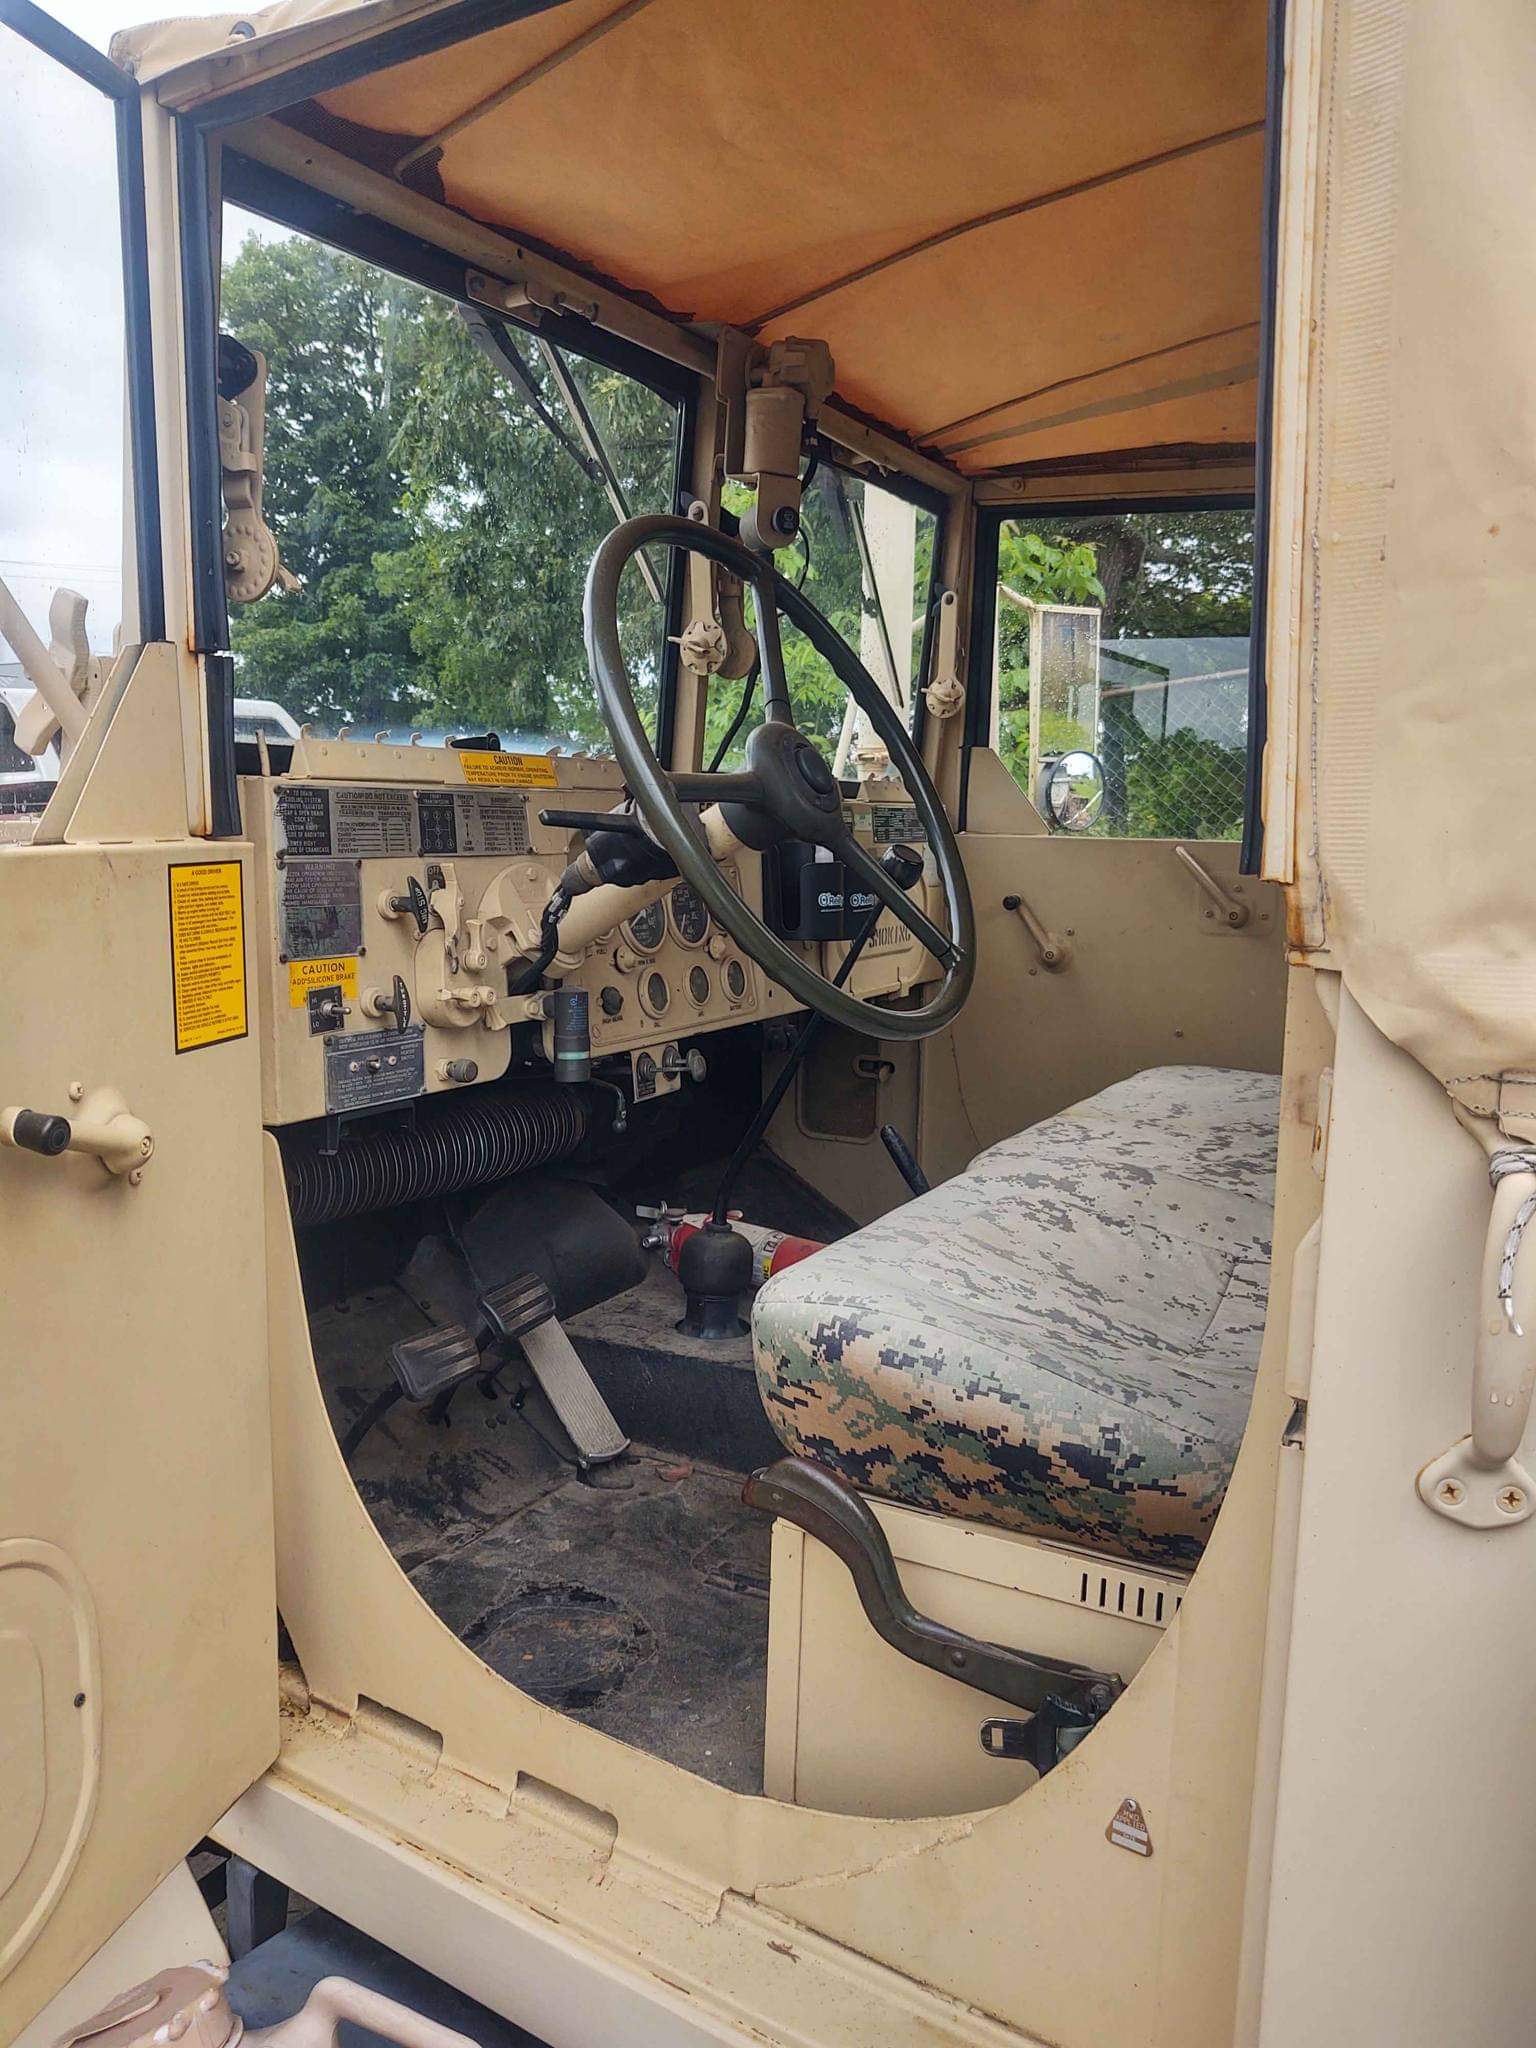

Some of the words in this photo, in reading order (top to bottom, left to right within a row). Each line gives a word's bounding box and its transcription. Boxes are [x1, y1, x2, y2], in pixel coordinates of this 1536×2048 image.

[493, 755, 523, 765] CAUTION
[303, 863, 336, 871] WARNING
[868, 924, 911, 949] SMOKING
[302, 962, 346, 975] CAUTION
[292, 977, 305, 986] ADD
[306, 975, 335, 984] SILICONE
[335, 972, 356, 981] BRAKE
[312, 1021, 320, 1029] LO
